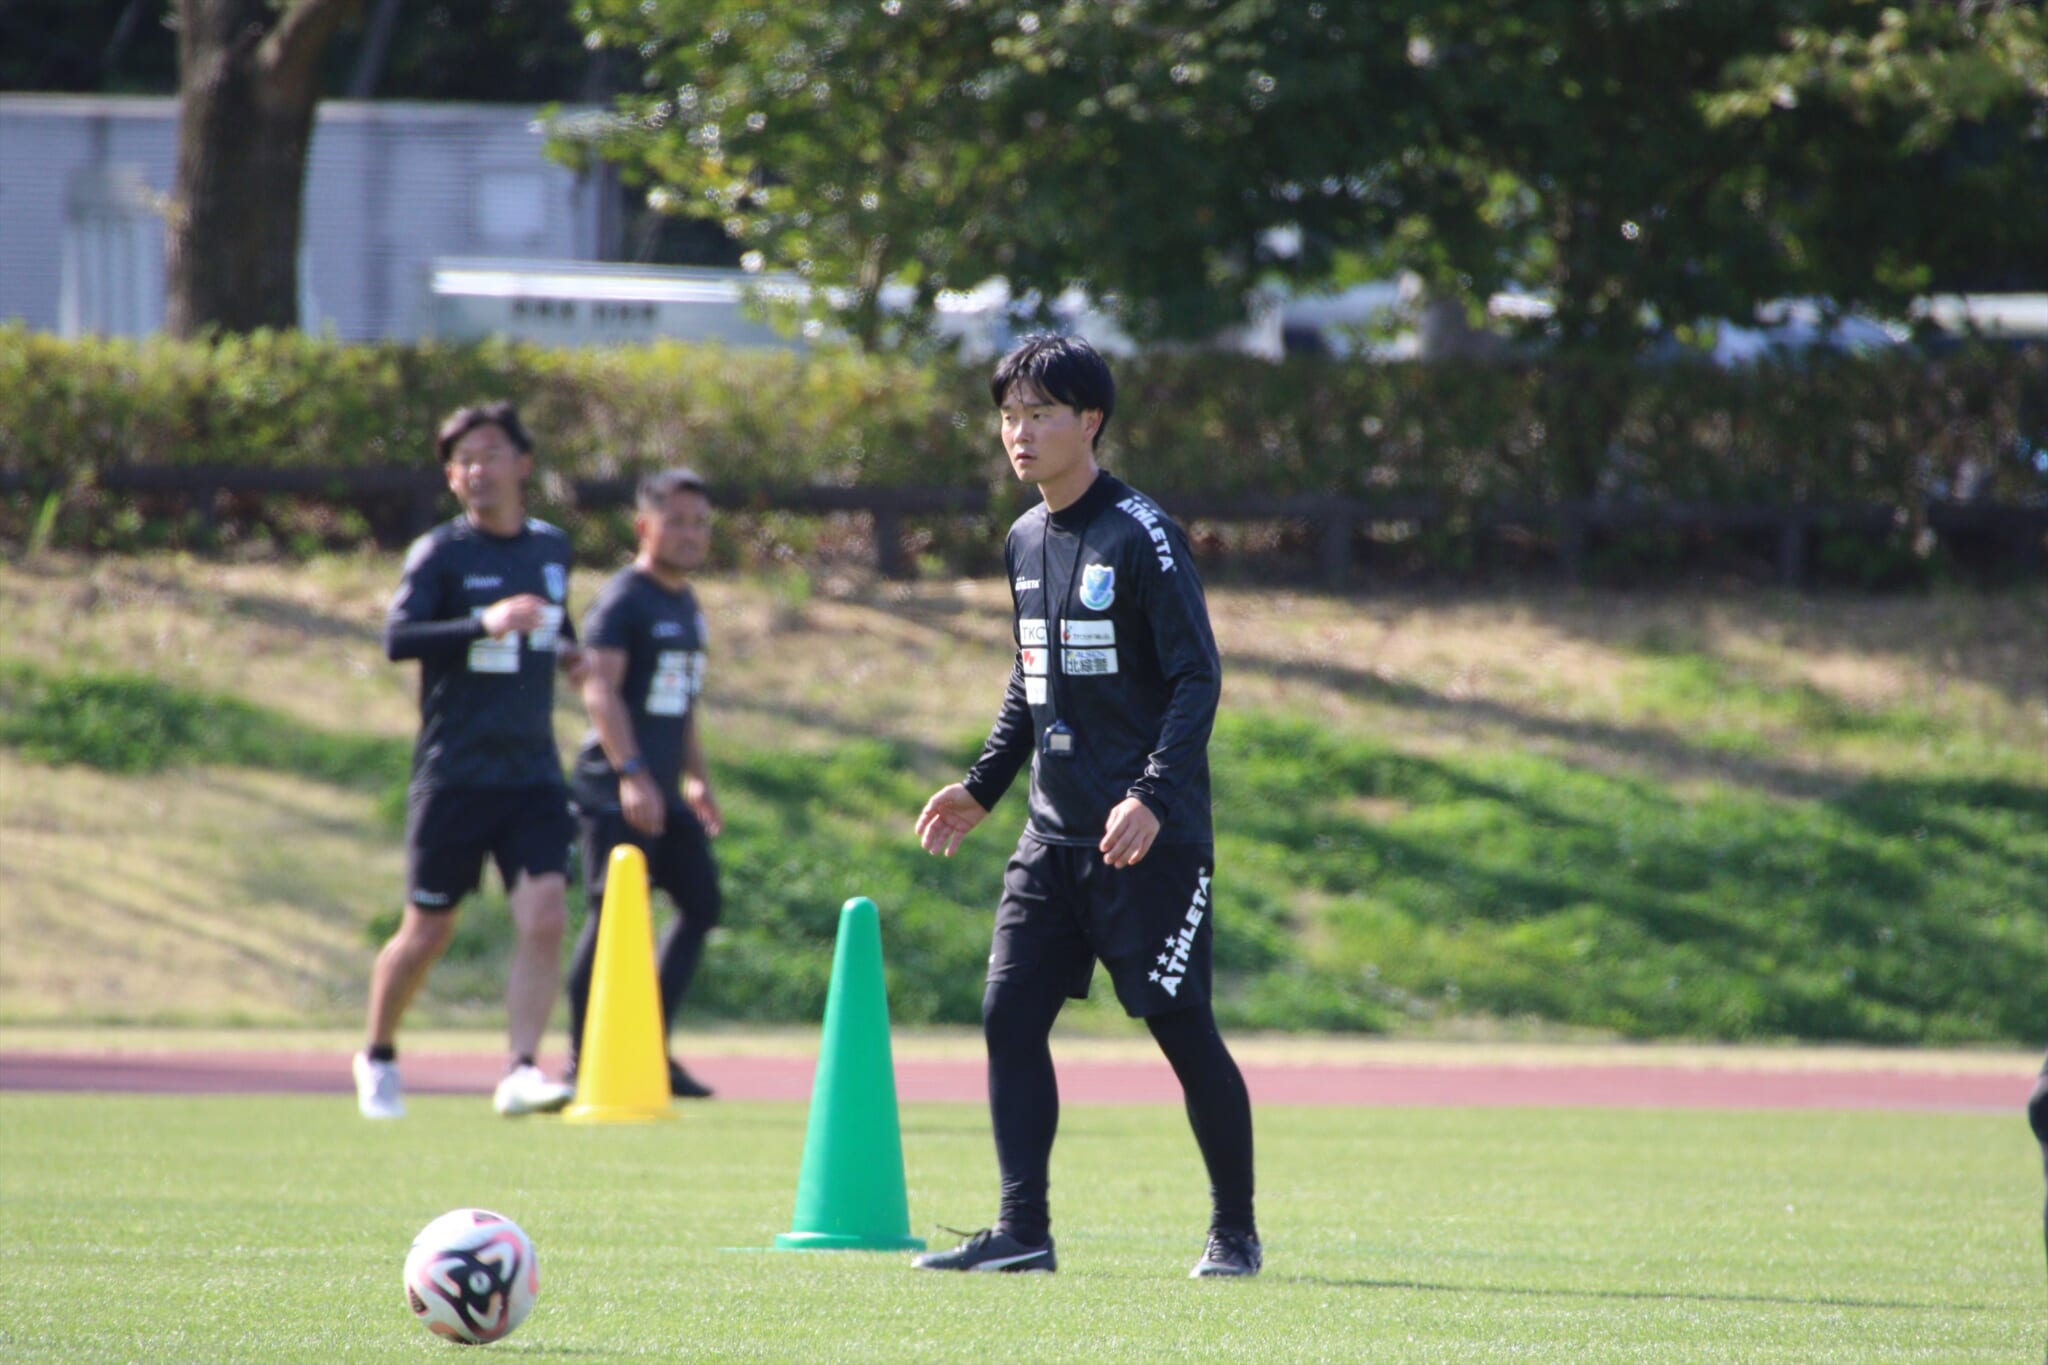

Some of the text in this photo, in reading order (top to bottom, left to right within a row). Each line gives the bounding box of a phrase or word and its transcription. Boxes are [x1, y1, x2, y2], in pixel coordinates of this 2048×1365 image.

[1115, 498, 1175, 573] ATHLETA
[1022, 626, 1046, 640] TKC
[1160, 876, 1211, 998] ATHLETA
